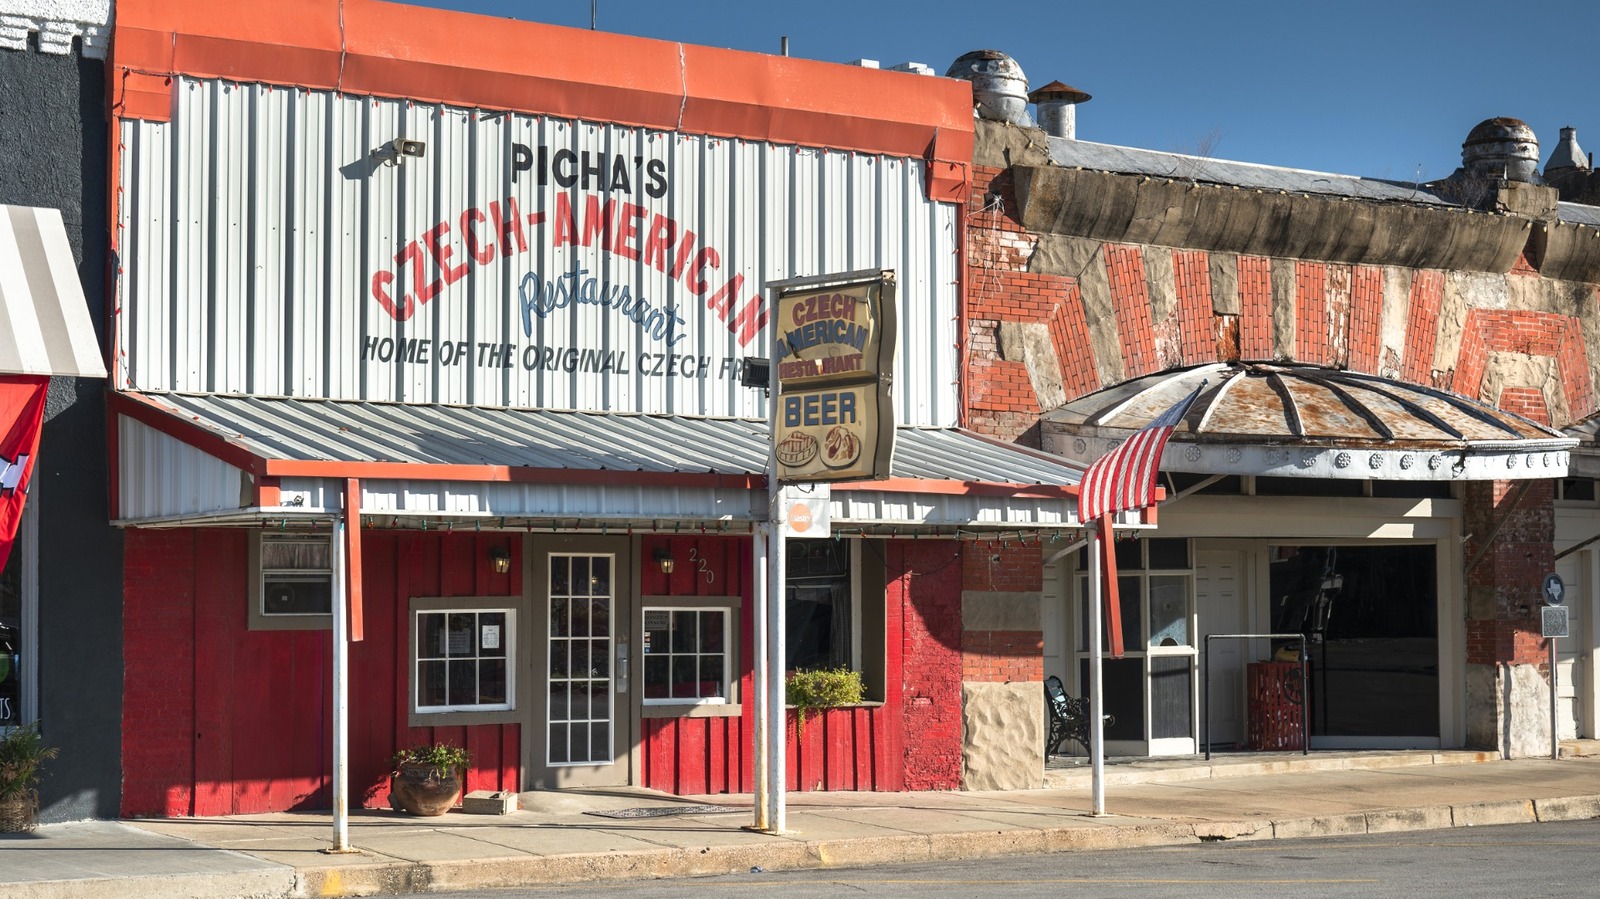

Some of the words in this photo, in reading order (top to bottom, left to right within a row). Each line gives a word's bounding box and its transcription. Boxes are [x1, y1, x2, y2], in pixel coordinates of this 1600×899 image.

[512, 142, 668, 198] PICHA'S
[518, 260, 687, 347] Restaurant
[792, 293, 857, 327] CZECH
[362, 335, 432, 364] HOME
[439, 340, 469, 366] OF
[477, 342, 516, 369] THE
[523, 345, 629, 374] ORIGINAL
[638, 352, 710, 378] CZECH
[719, 357, 743, 381] FR
[777, 319, 868, 363] AMERICAN
[778, 353, 863, 379] RESTARANT
[785, 392, 856, 427] BEER
[689, 548, 714, 584] 220
